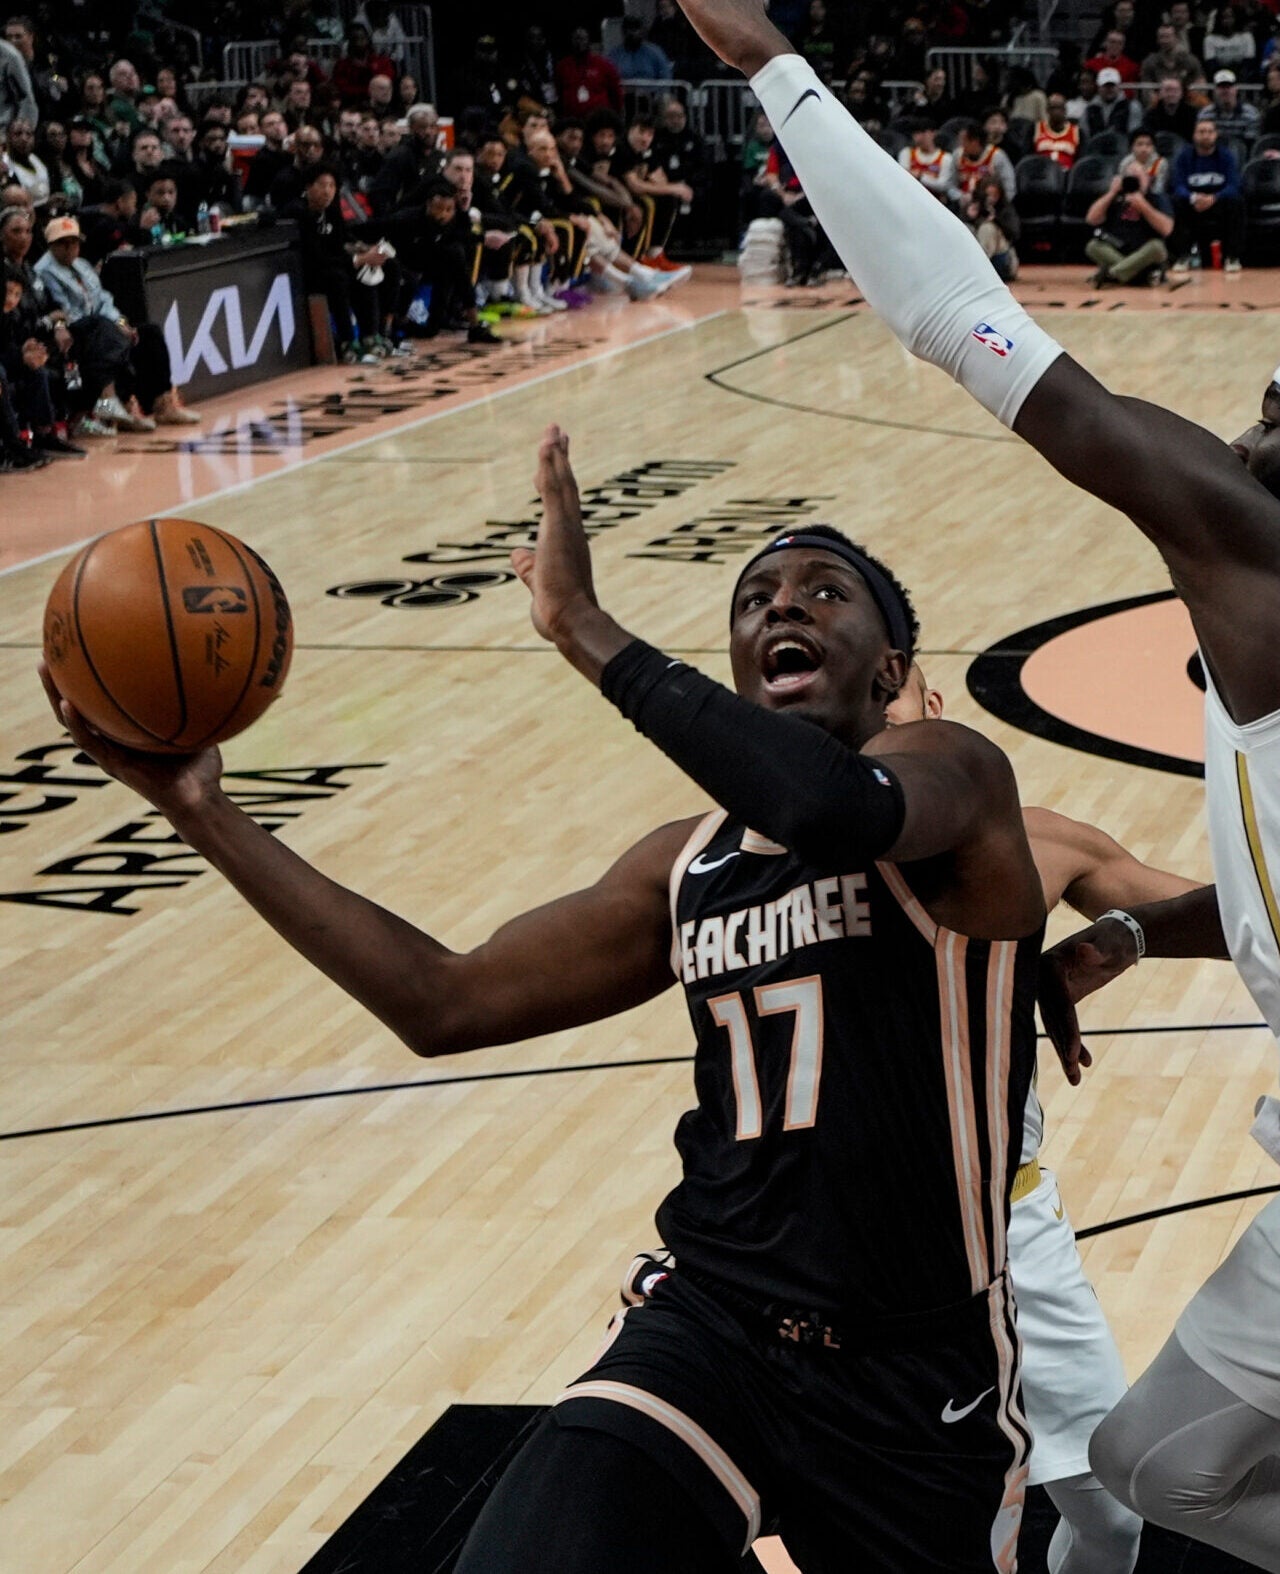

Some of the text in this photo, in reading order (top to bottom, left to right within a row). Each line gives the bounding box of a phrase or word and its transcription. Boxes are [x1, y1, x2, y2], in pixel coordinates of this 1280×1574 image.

[163, 272, 295, 386] KIA
[681, 872, 873, 985] EACHTREE
[706, 974, 825, 1141] 17
